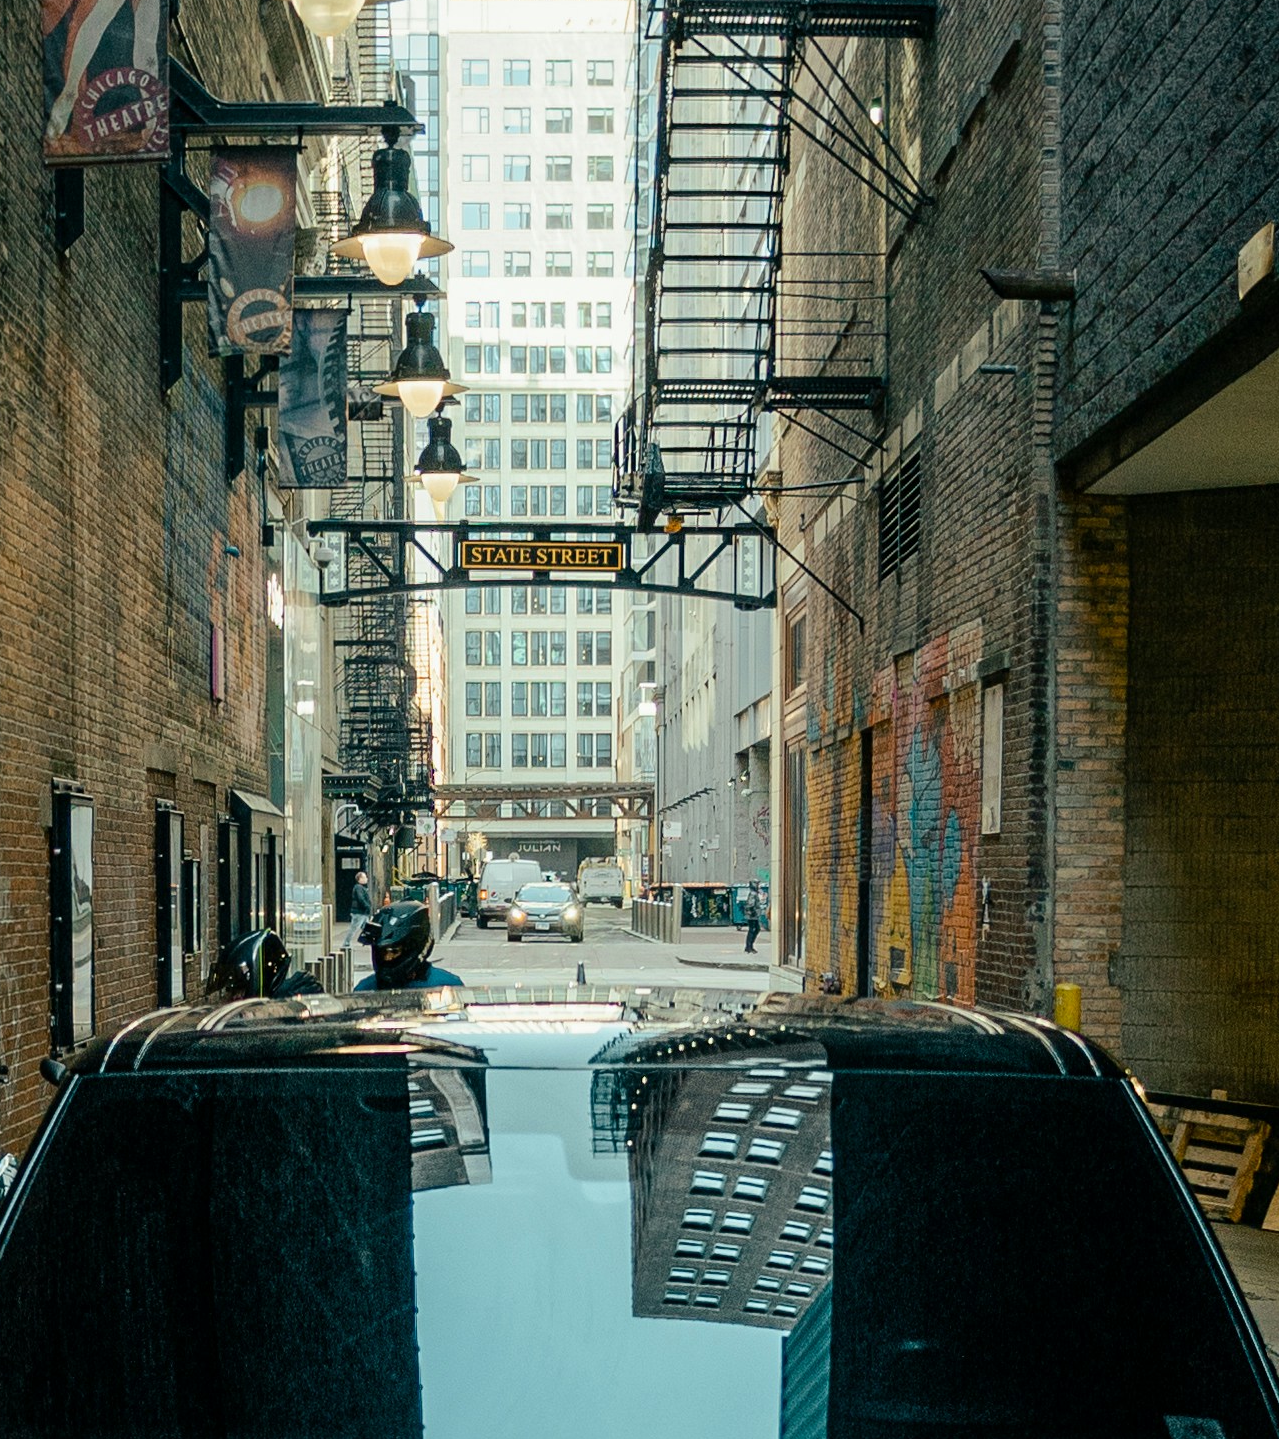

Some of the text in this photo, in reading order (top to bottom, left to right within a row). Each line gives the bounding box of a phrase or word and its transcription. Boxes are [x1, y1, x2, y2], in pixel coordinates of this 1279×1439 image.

[81, 70, 150, 109] CHICAGO
[83, 94, 167, 141] THEATRE
[299, 438, 337, 458] CHICAGO
[301, 451, 346, 477] THEATRE
[471, 547, 611, 564] STATE STREET
[518, 843, 561, 853] JULIAN
